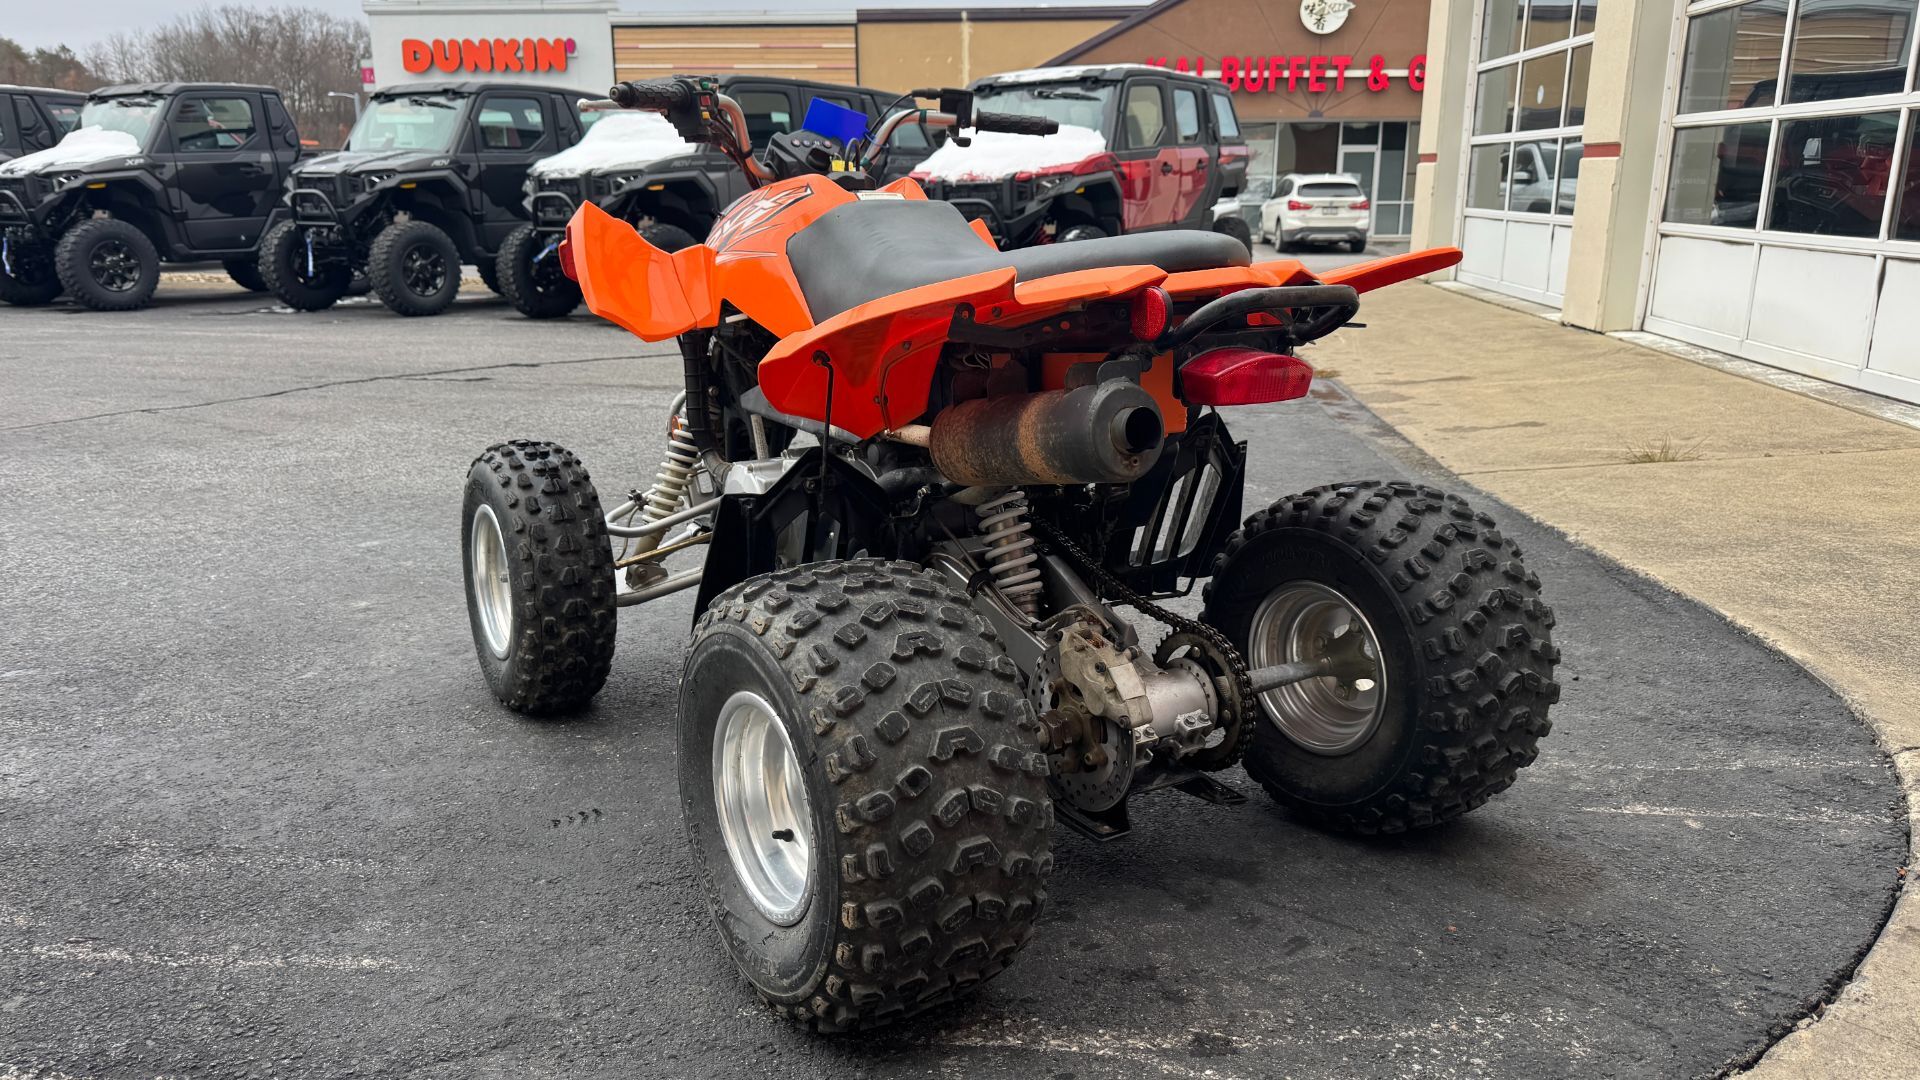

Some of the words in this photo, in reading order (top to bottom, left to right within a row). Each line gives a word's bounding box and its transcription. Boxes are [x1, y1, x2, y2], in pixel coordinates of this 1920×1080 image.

[402, 38, 576, 73] DUNKIN'
[1221, 56, 1352, 92] BUFFET
[1367, 54, 1390, 92] &
